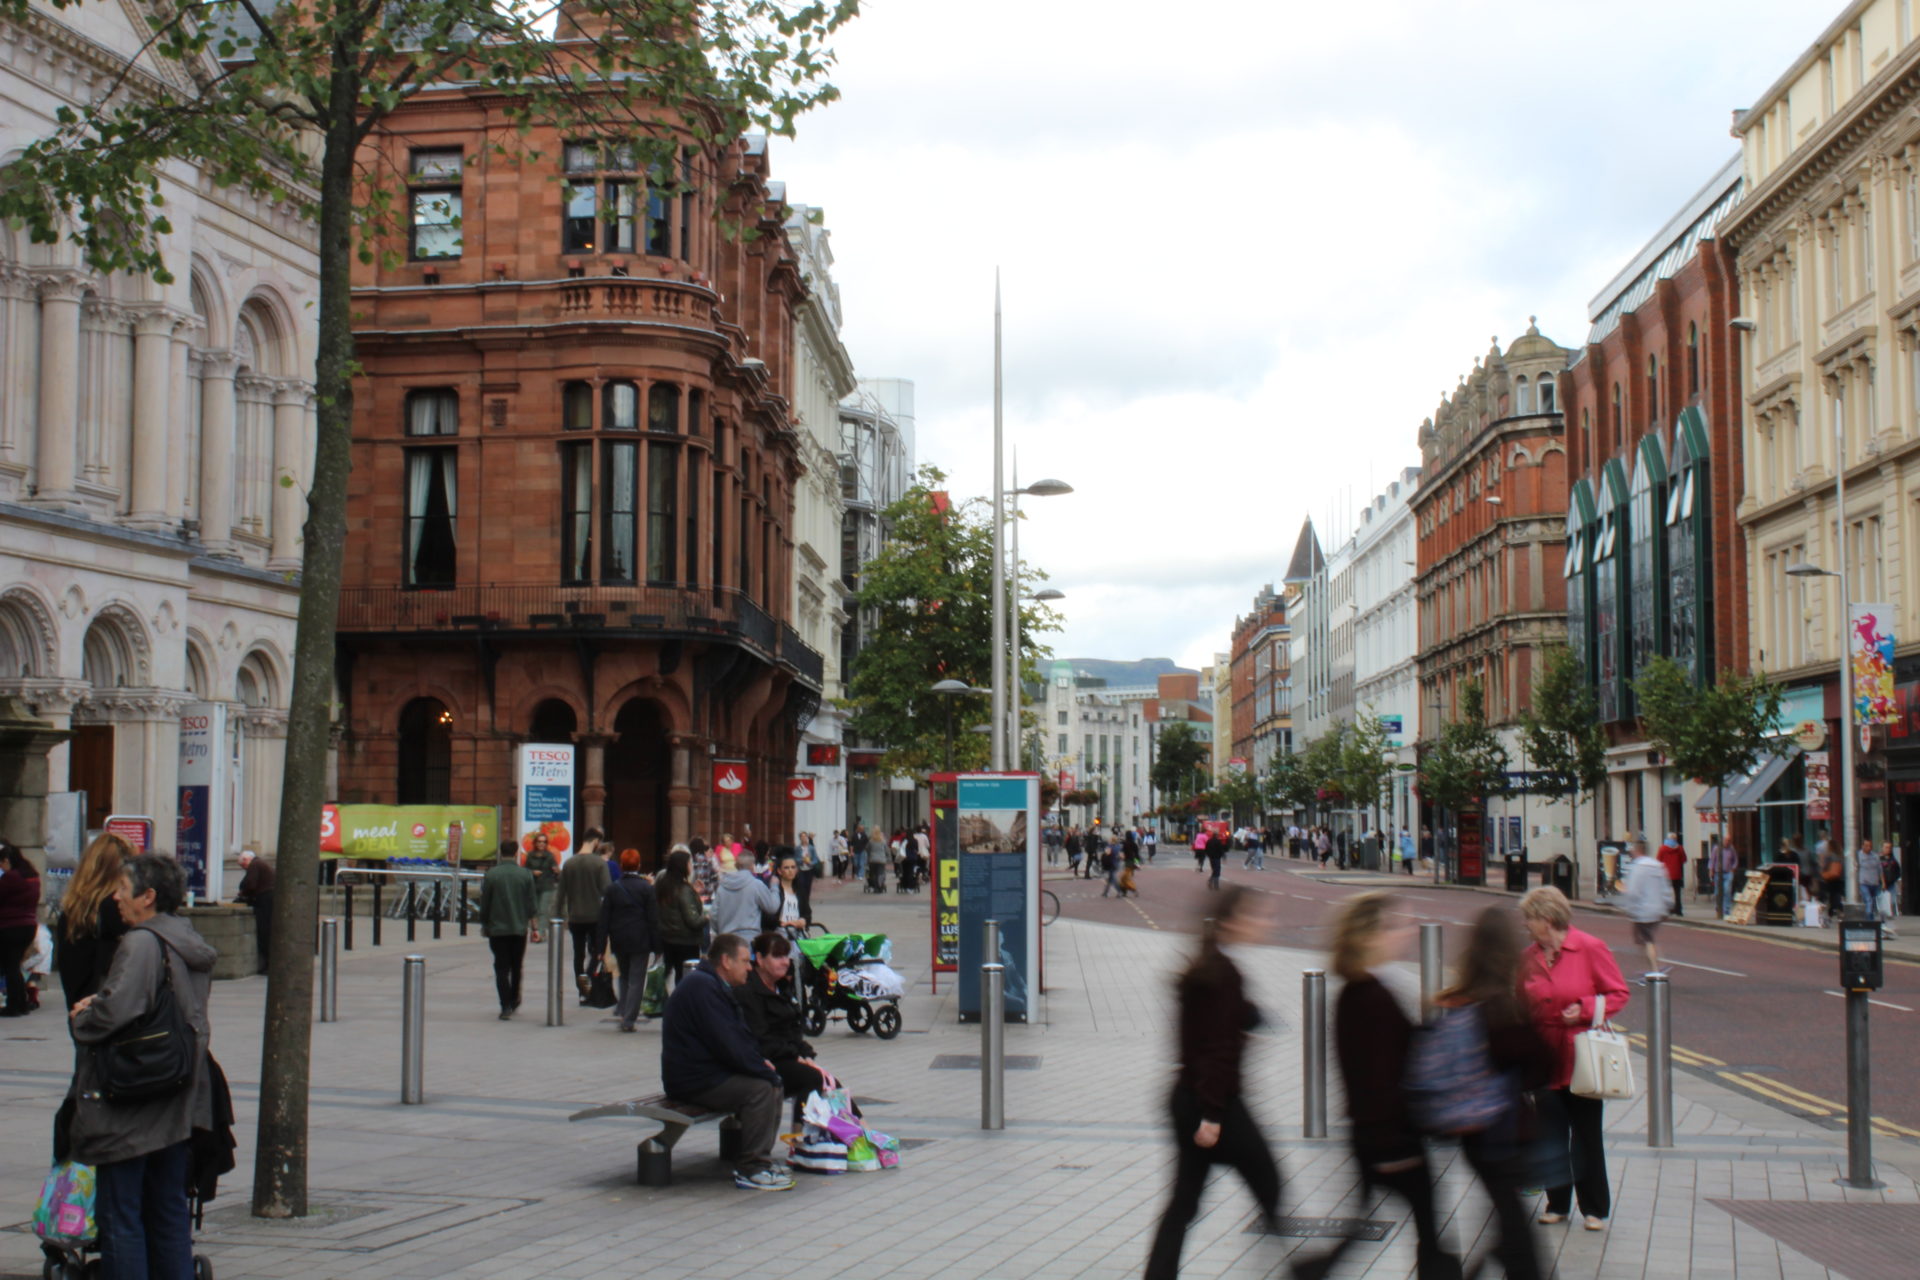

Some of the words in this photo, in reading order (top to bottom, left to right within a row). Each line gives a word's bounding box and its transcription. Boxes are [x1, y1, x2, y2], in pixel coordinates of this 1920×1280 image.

[528, 750, 570, 761] TESCO
[531, 766, 567, 777] Metro
[353, 821, 398, 840] meal
[355, 837, 399, 851] DEAL
